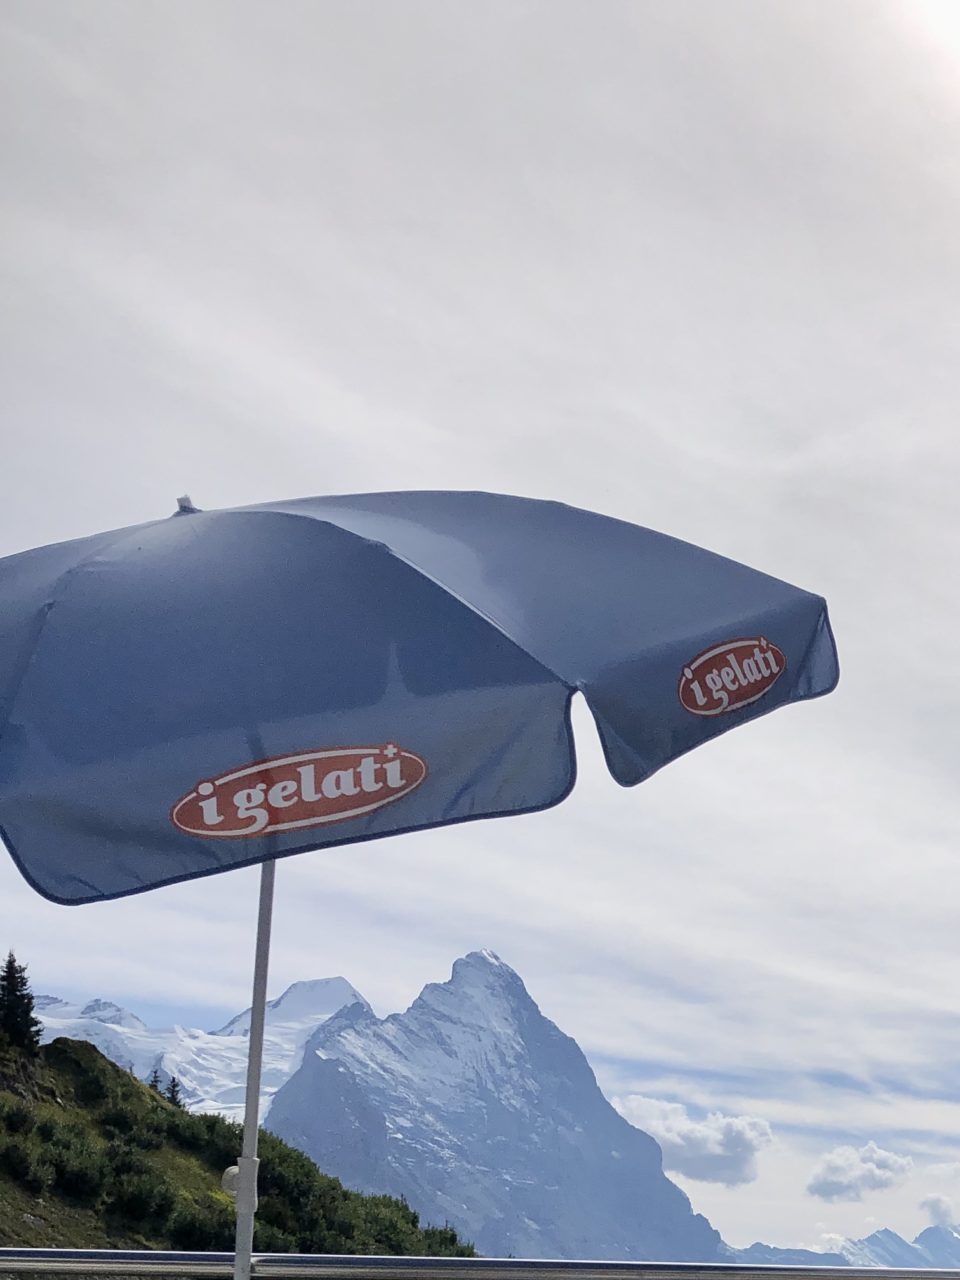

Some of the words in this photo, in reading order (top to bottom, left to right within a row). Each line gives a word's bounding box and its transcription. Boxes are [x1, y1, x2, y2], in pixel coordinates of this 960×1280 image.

[684, 667, 707, 706] i
[705, 636, 780, 714] gelati
[198, 782, 225, 826] i
[232, 744, 407, 834] gelati
